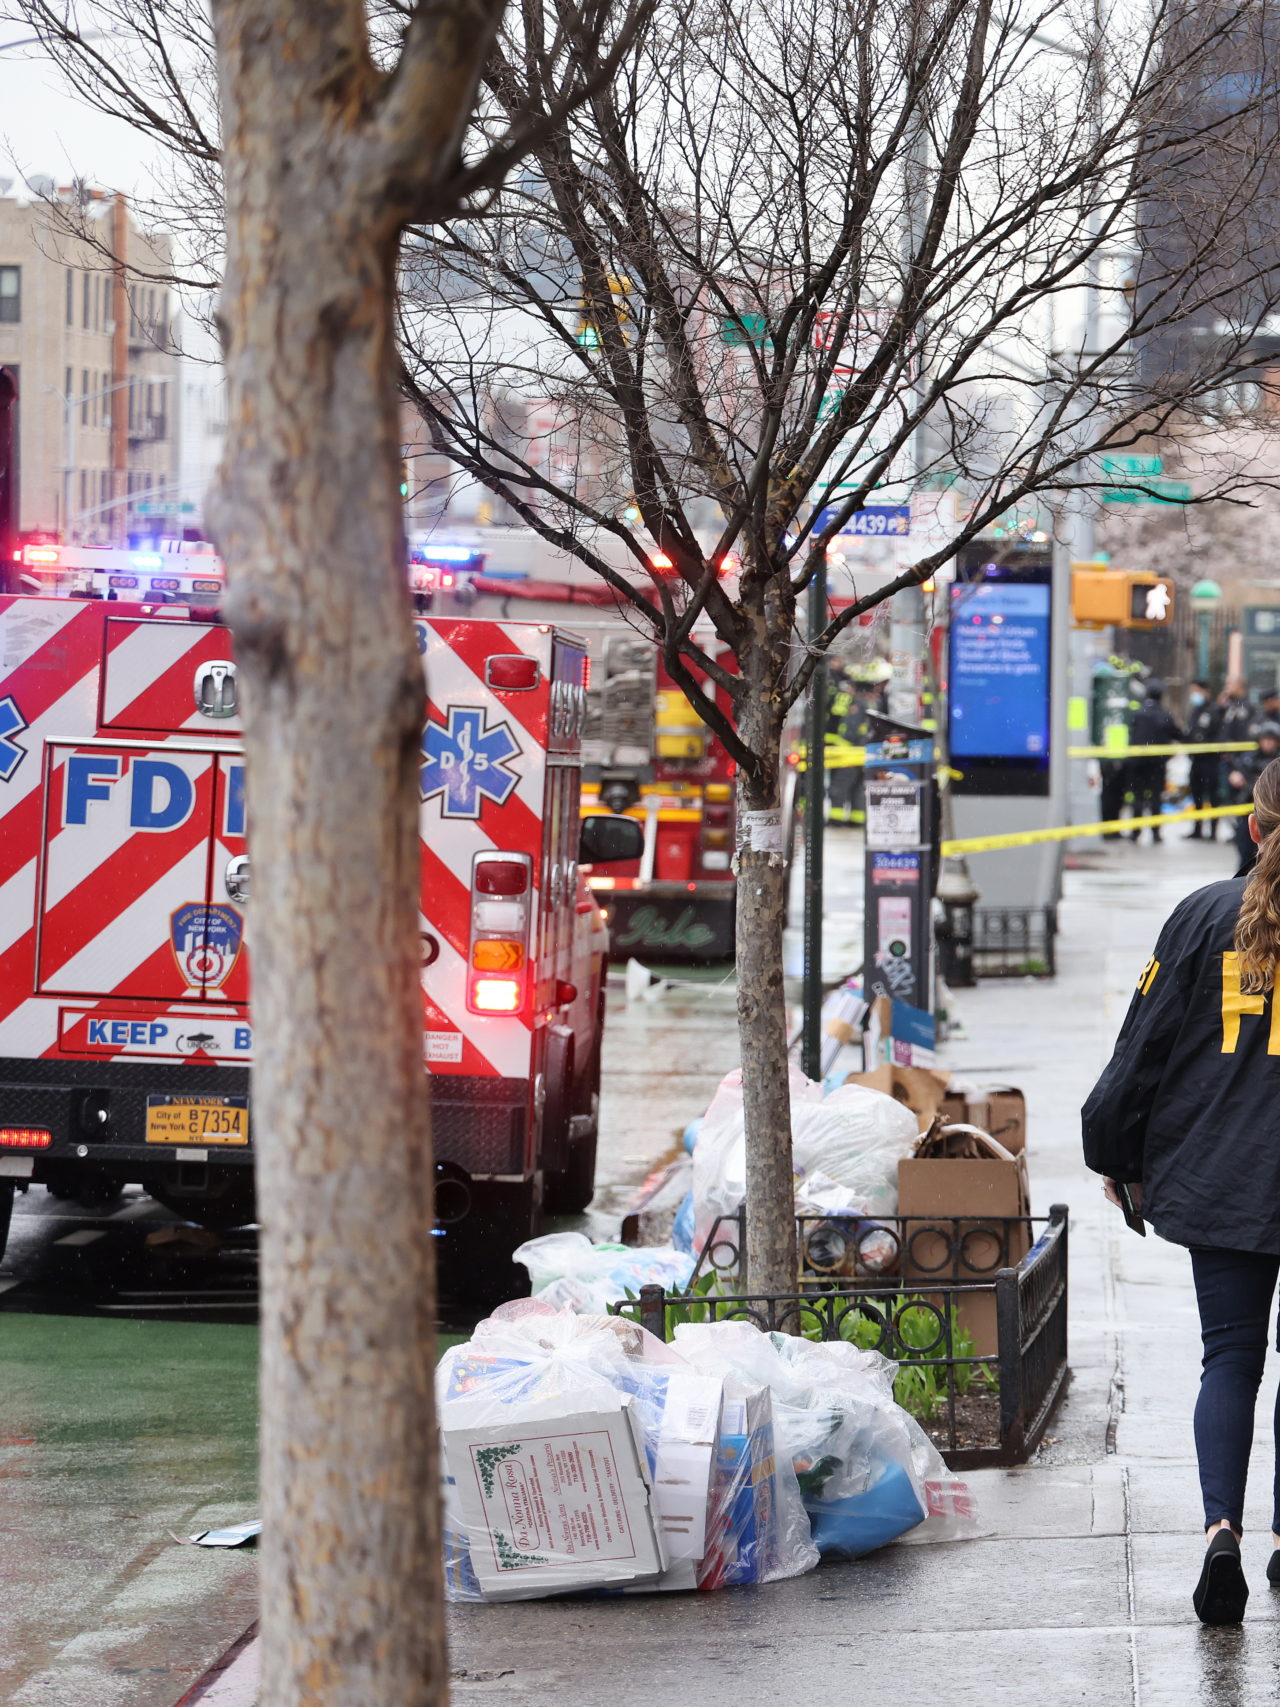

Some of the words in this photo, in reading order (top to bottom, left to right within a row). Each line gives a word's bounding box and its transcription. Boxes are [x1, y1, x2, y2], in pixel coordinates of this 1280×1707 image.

[178, 911, 193, 927] FIRE
[193, 907, 238, 929] DEPARTMENT
[207, 925, 227, 933] YORK
[1135, 953, 1161, 997] BI
[88, 1020, 169, 1045] KEEP
[425, 1033, 459, 1041] DANGER
[187, 1041, 221, 1050] UNLOCK
[172, 1097, 198, 1106] NEW
[199, 1097, 223, 1106] YORK
[156, 1111, 171, 1121] City
[173, 1111, 182, 1120] of
[202, 1110, 241, 1133] 7354
[151, 1122, 168, 1132] New
[169, 1122, 186, 1132] York
[504, 1463, 518, 1489] Rosa
[602, 1456, 612, 1477] TAKEOUT
[608, 1482, 618, 1505] DELIVERY
[510, 1491, 526, 1529] Nonna
[517, 1531, 530, 1546] Da
